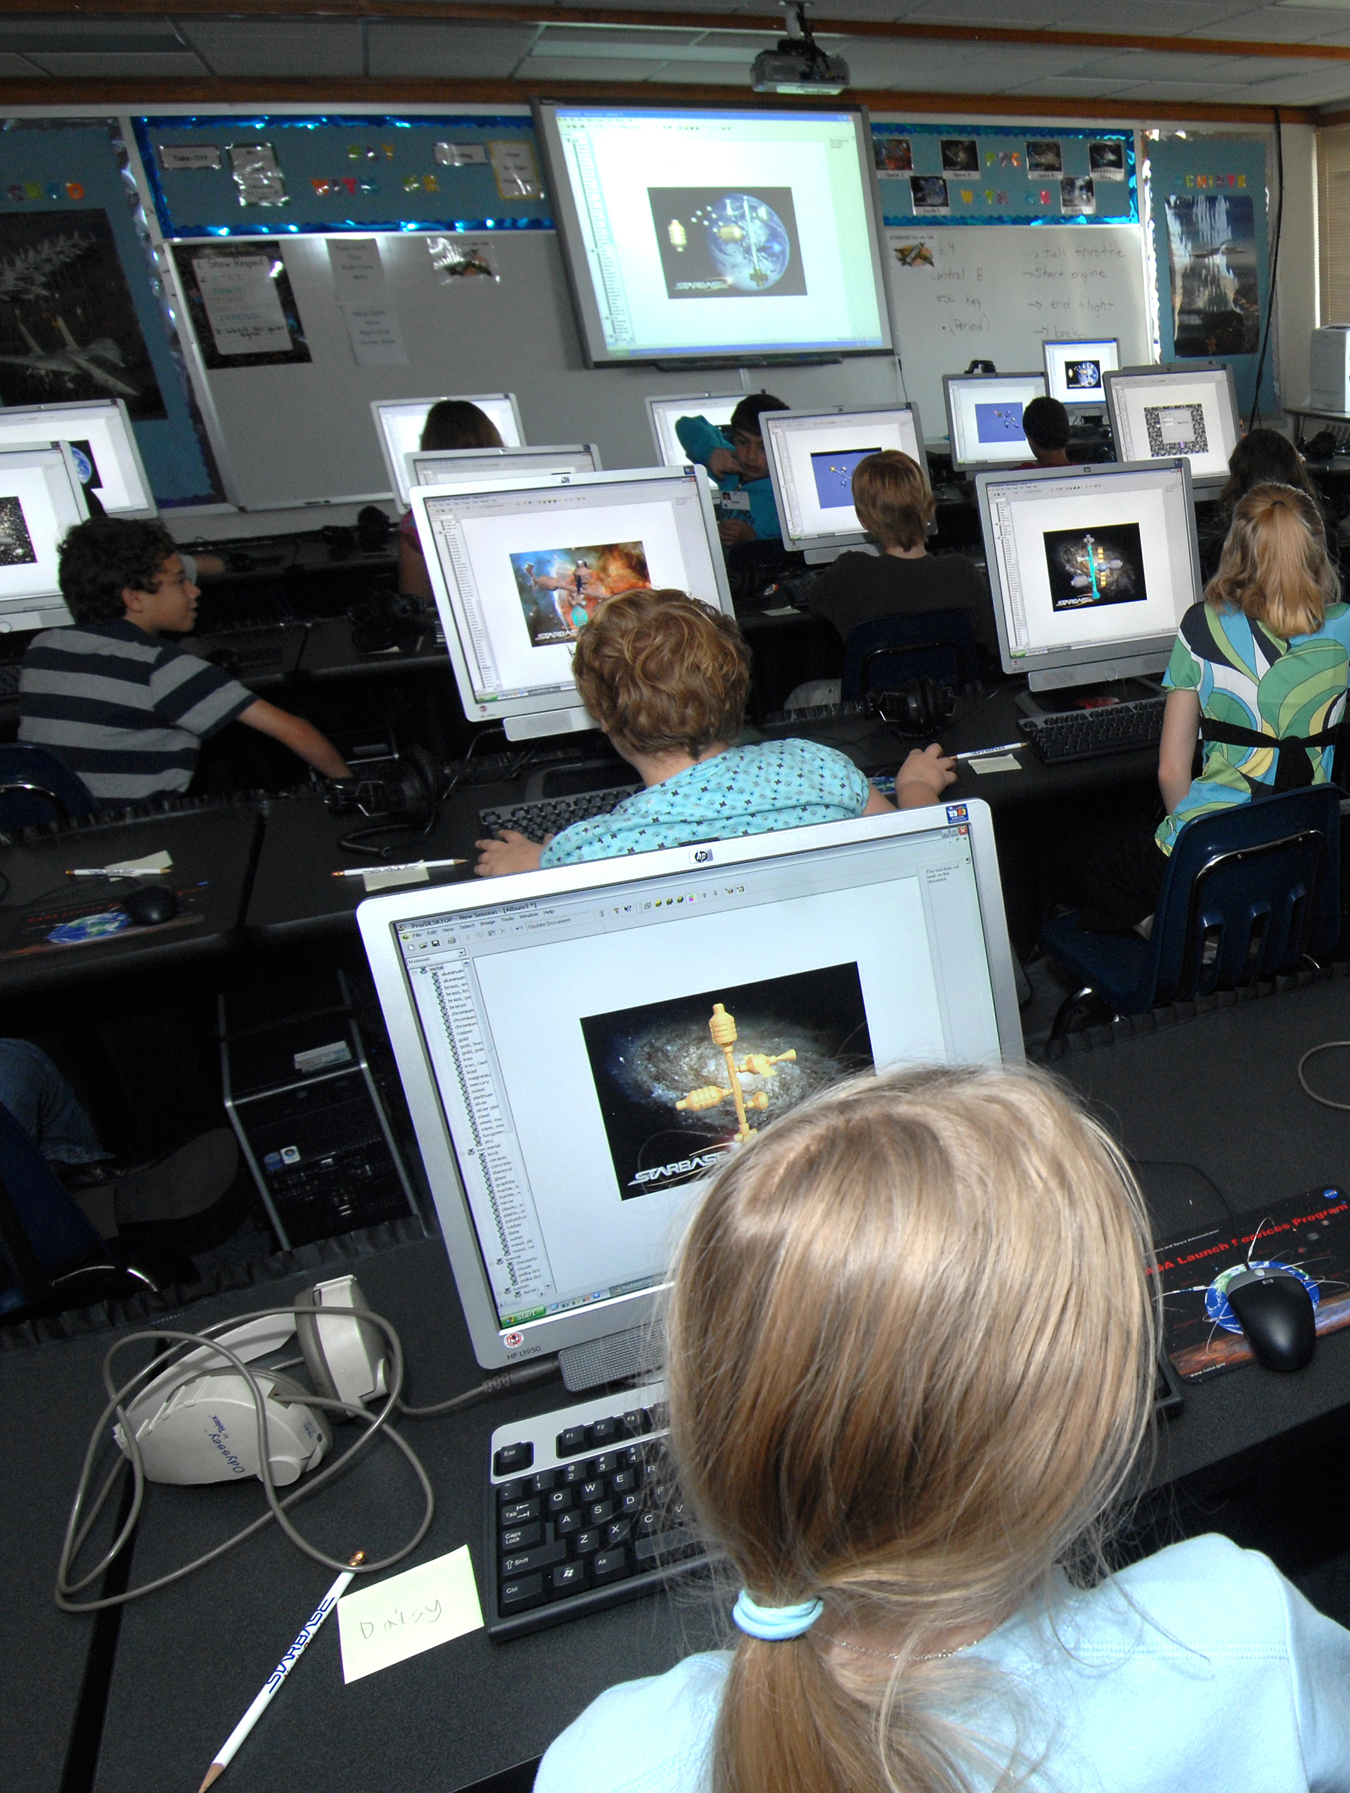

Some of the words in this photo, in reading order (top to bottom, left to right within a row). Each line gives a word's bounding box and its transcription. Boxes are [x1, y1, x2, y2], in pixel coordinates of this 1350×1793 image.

[695, 851, 708, 863] hp
[459, 910, 473, 920] New
[474, 908, 498, 919] Session
[480, 919, 496, 927] Image
[543, 908, 555, 916] Help
[1177, 1242, 1230, 1265] Launch
[1231, 1223, 1291, 1247] Services
[1292, 1203, 1349, 1226] Program
[517, 1311, 536, 1321] start
[506, 1352, 518, 1361] HP
[519, 1345, 541, 1358] L1950
[1190, 1362, 1226, 1378] www.nasa.gov
[209, 1432, 245, 1473] Odyssey
[504, 1449, 516, 1457] Esc
[585, 1484, 596, 1492] W
[553, 1493, 563, 1502] Q
[505, 1530, 522, 1539] Caps
[514, 1556, 529, 1565] Shift
[506, 1586, 518, 1594] Ctrl
[360, 1599, 442, 1639] Daisy
[266, 1596, 336, 1694] STARBASE
